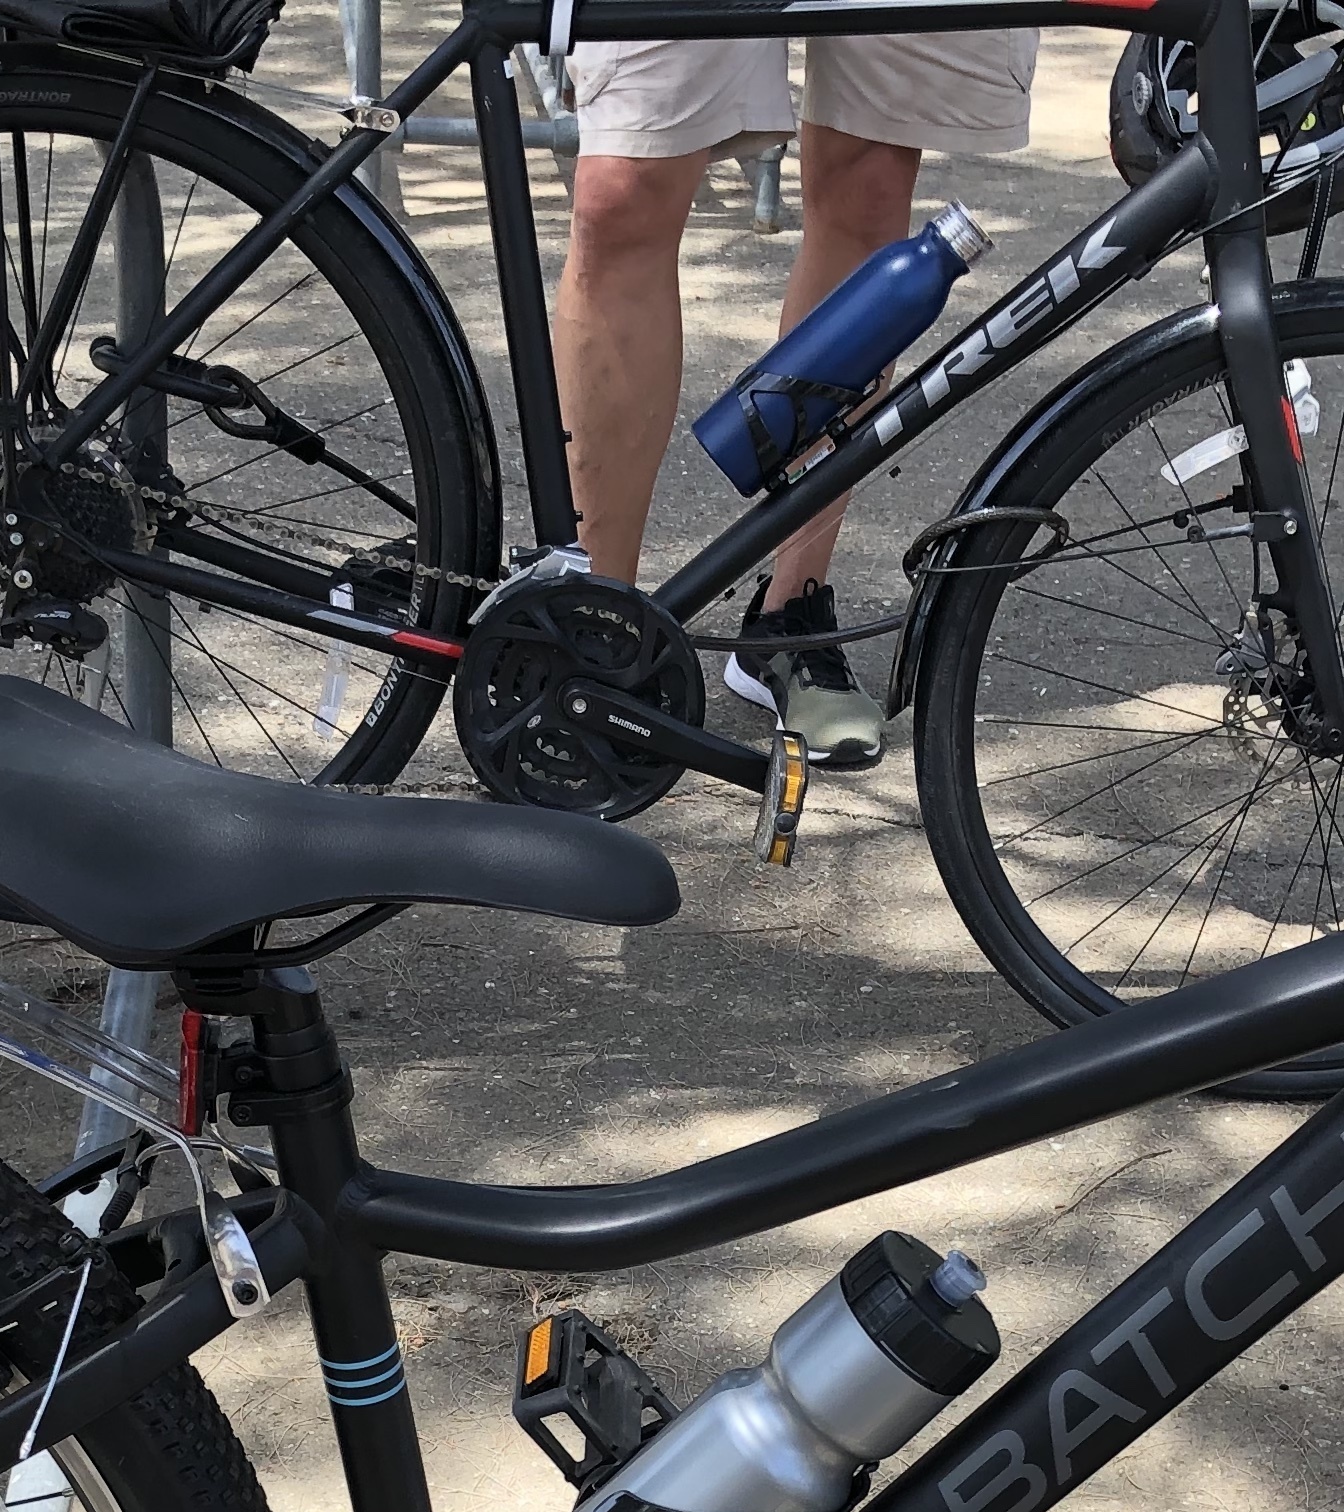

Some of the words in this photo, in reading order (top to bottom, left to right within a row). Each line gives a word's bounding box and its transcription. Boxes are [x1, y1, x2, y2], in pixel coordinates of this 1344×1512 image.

[874, 217, 1126, 447] TREK
[1128, 369, 1230, 431] ONTRAGER
[608, 714, 651, 737] SHIMANO
